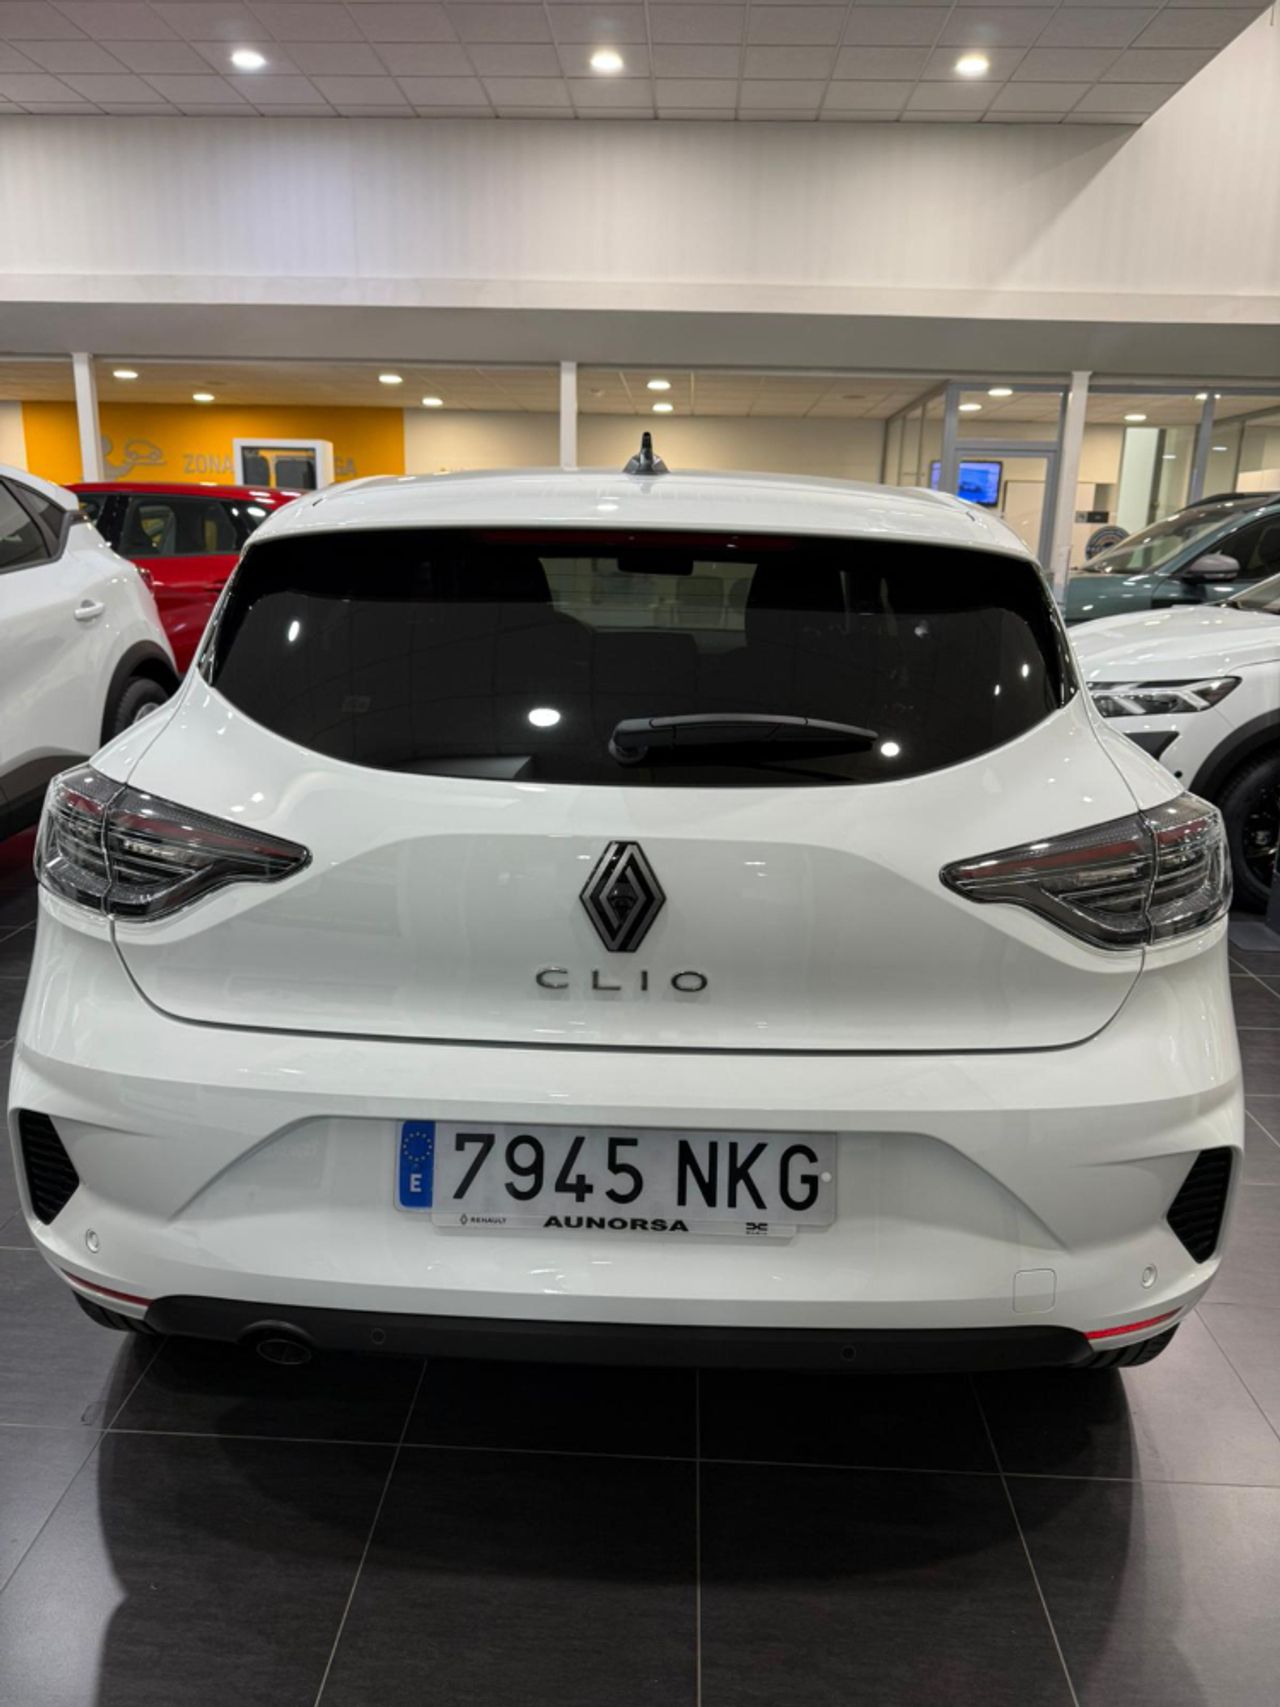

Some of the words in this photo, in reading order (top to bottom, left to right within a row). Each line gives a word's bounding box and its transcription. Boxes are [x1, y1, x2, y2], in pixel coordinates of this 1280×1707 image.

[183, 454, 235, 474] ZONA
[535, 967, 708, 992] CLIO
[452, 1133, 643, 1204] 7945
[676, 1140, 819, 1211] NKG
[410, 1174, 422, 1192] E
[543, 1215, 689, 1232] AUNORSA
